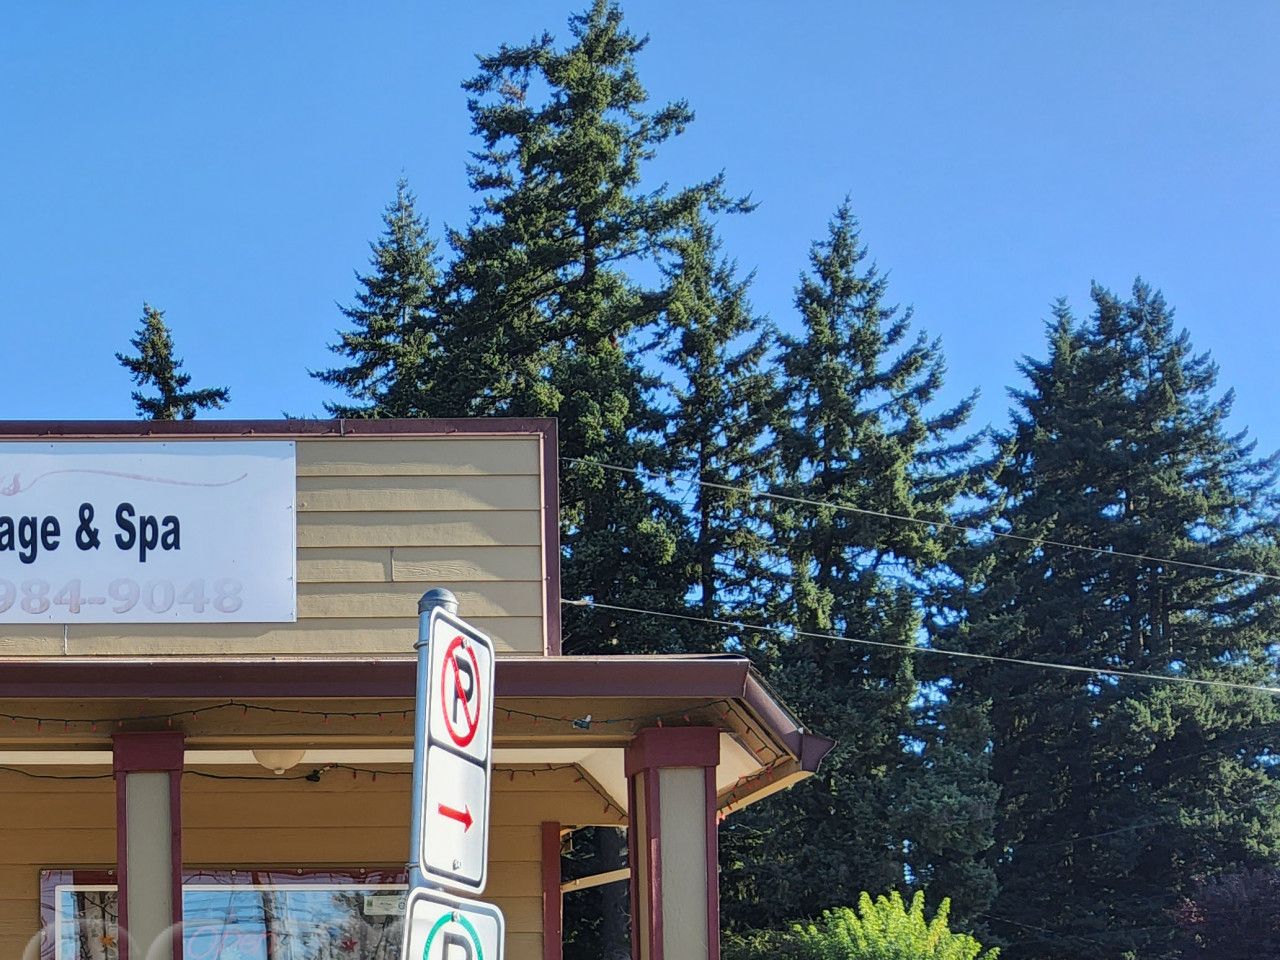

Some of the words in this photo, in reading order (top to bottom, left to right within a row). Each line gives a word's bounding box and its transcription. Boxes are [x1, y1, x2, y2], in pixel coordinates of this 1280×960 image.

[75, 502, 100, 550] &
[114, 502, 181, 562] Spa
[453, 655, 474, 724] P
